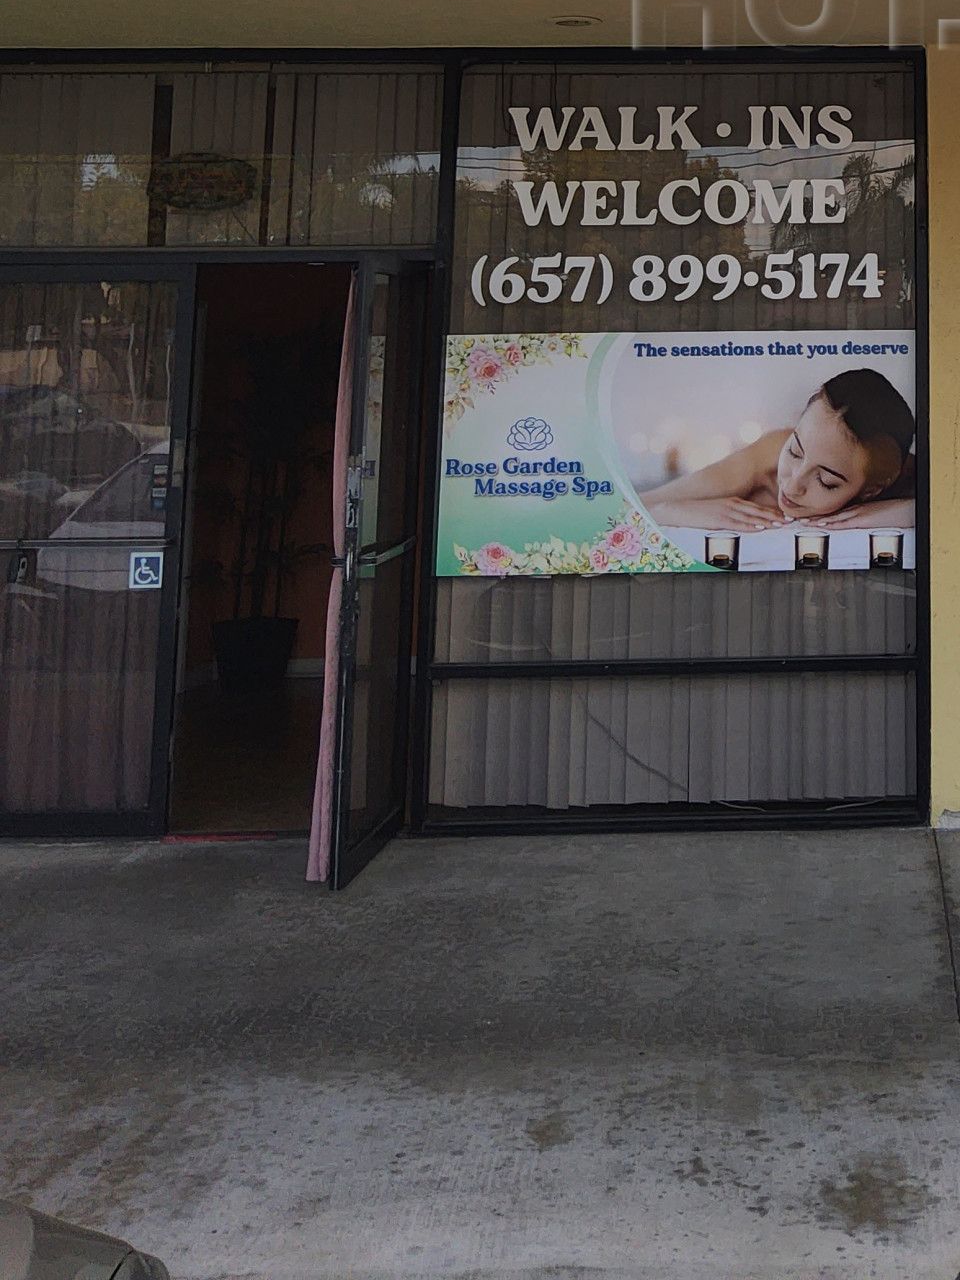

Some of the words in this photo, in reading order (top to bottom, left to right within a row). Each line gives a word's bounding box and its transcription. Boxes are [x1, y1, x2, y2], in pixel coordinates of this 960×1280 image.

[508, 106, 702, 152] WALK
[748, 105, 853, 150] INS
[512, 176, 847, 227] WELCOME
[471, 252, 613, 307] (657)
[634, 342, 668, 357] The
[670, 341, 764, 357] sensations
[768, 341, 803, 356] that
[806, 343, 838, 359] you
[841, 340, 909, 356] deserve
[445, 458, 498, 476] Rose
[502, 456, 583, 475] Garden
[474, 477, 568, 499] Massage
[571, 475, 614, 499] Spa
